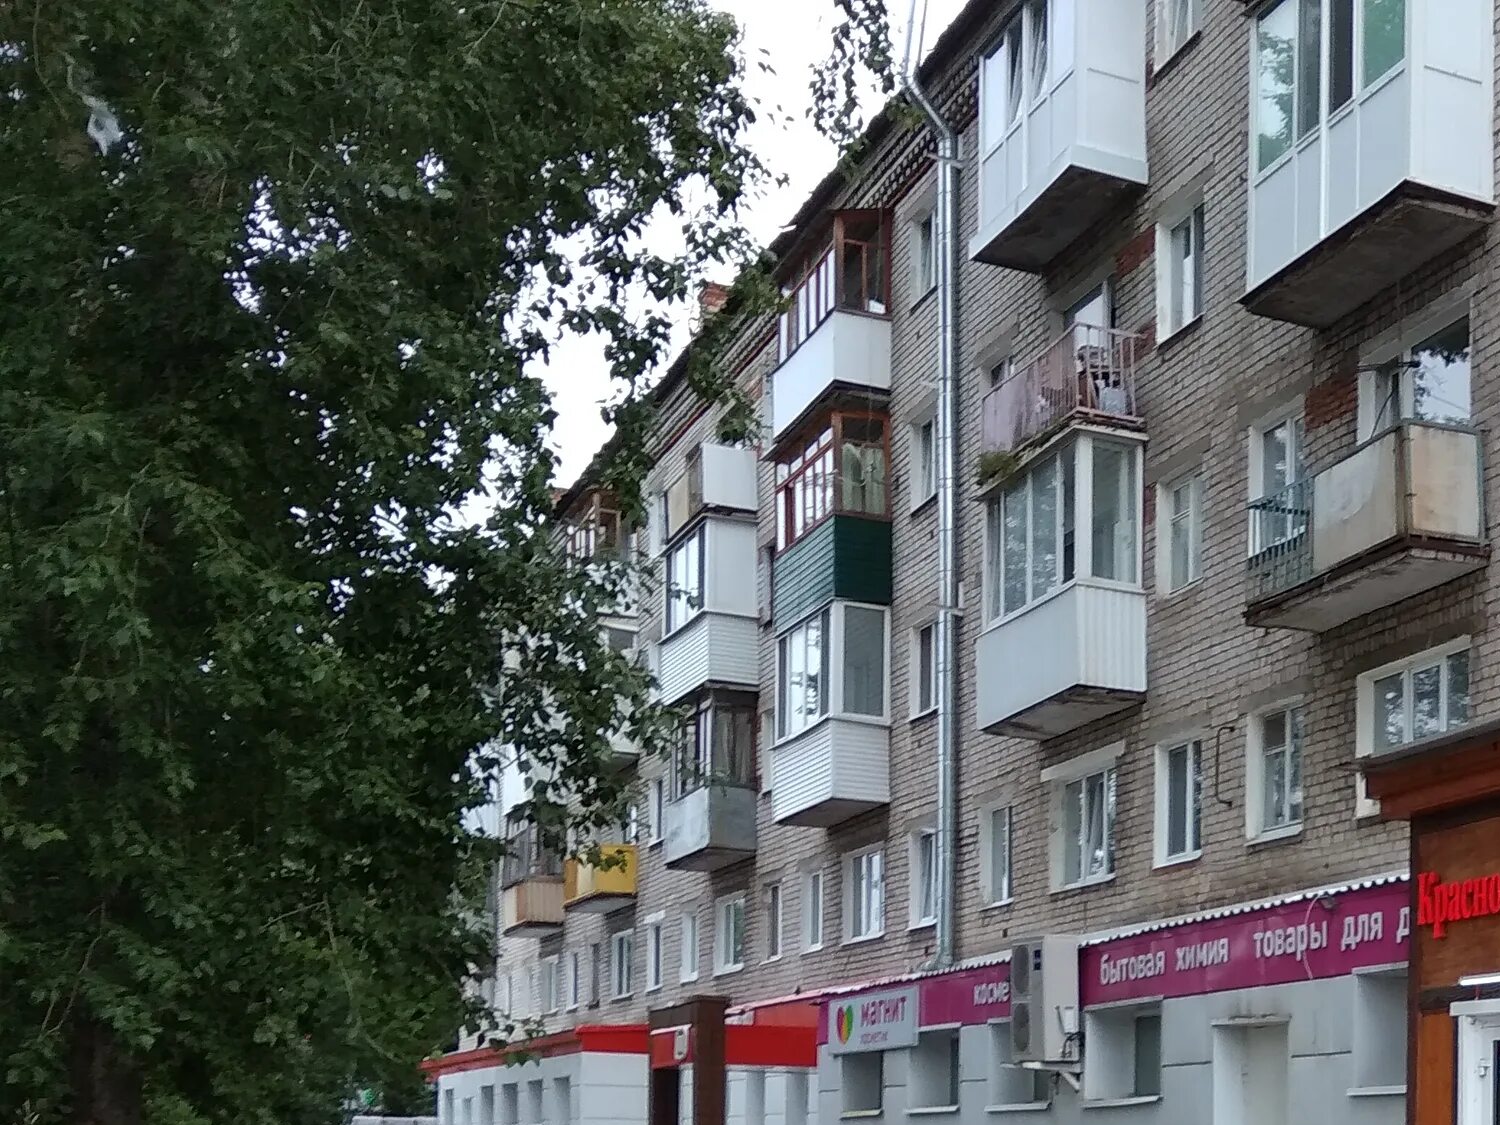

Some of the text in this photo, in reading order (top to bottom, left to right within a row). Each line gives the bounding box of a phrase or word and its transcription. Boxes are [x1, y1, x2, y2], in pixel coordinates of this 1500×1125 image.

[1099, 952, 1167, 986] бытовая
[1175, 937, 1230, 972] химия
[1253, 920, 1329, 960] товары
[1340, 911, 1384, 951] для
[860, 996, 907, 1028] магнит
